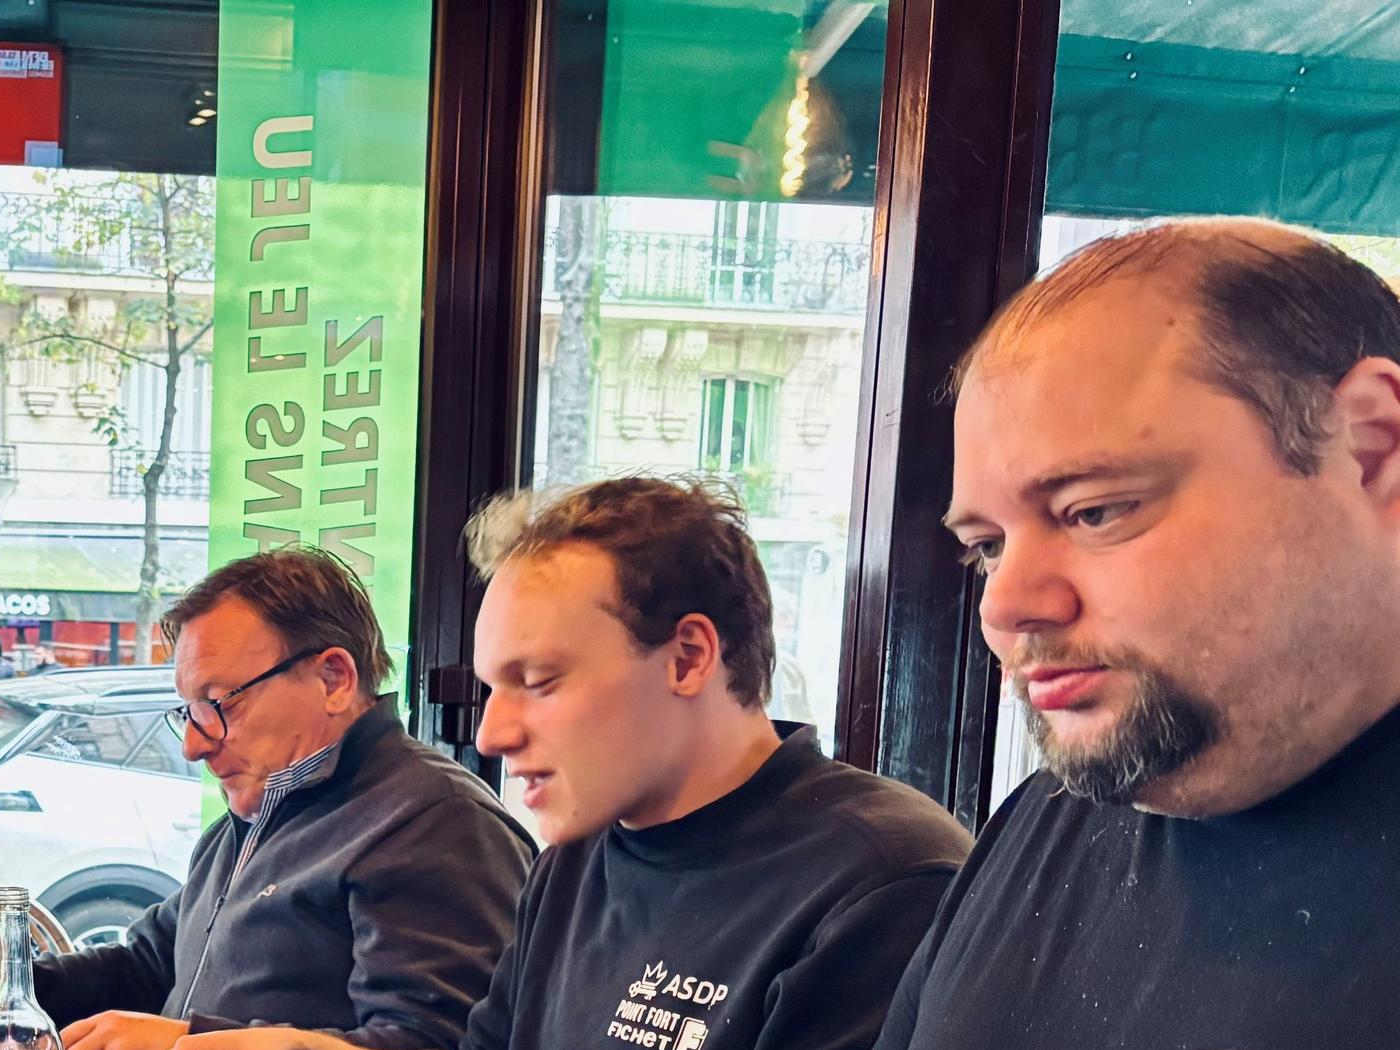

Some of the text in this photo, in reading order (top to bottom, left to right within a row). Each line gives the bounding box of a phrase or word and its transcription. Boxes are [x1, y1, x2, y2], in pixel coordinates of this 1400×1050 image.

[661, 973, 729, 1009] ASDP
[615, 999, 681, 1032] POINT FORT
